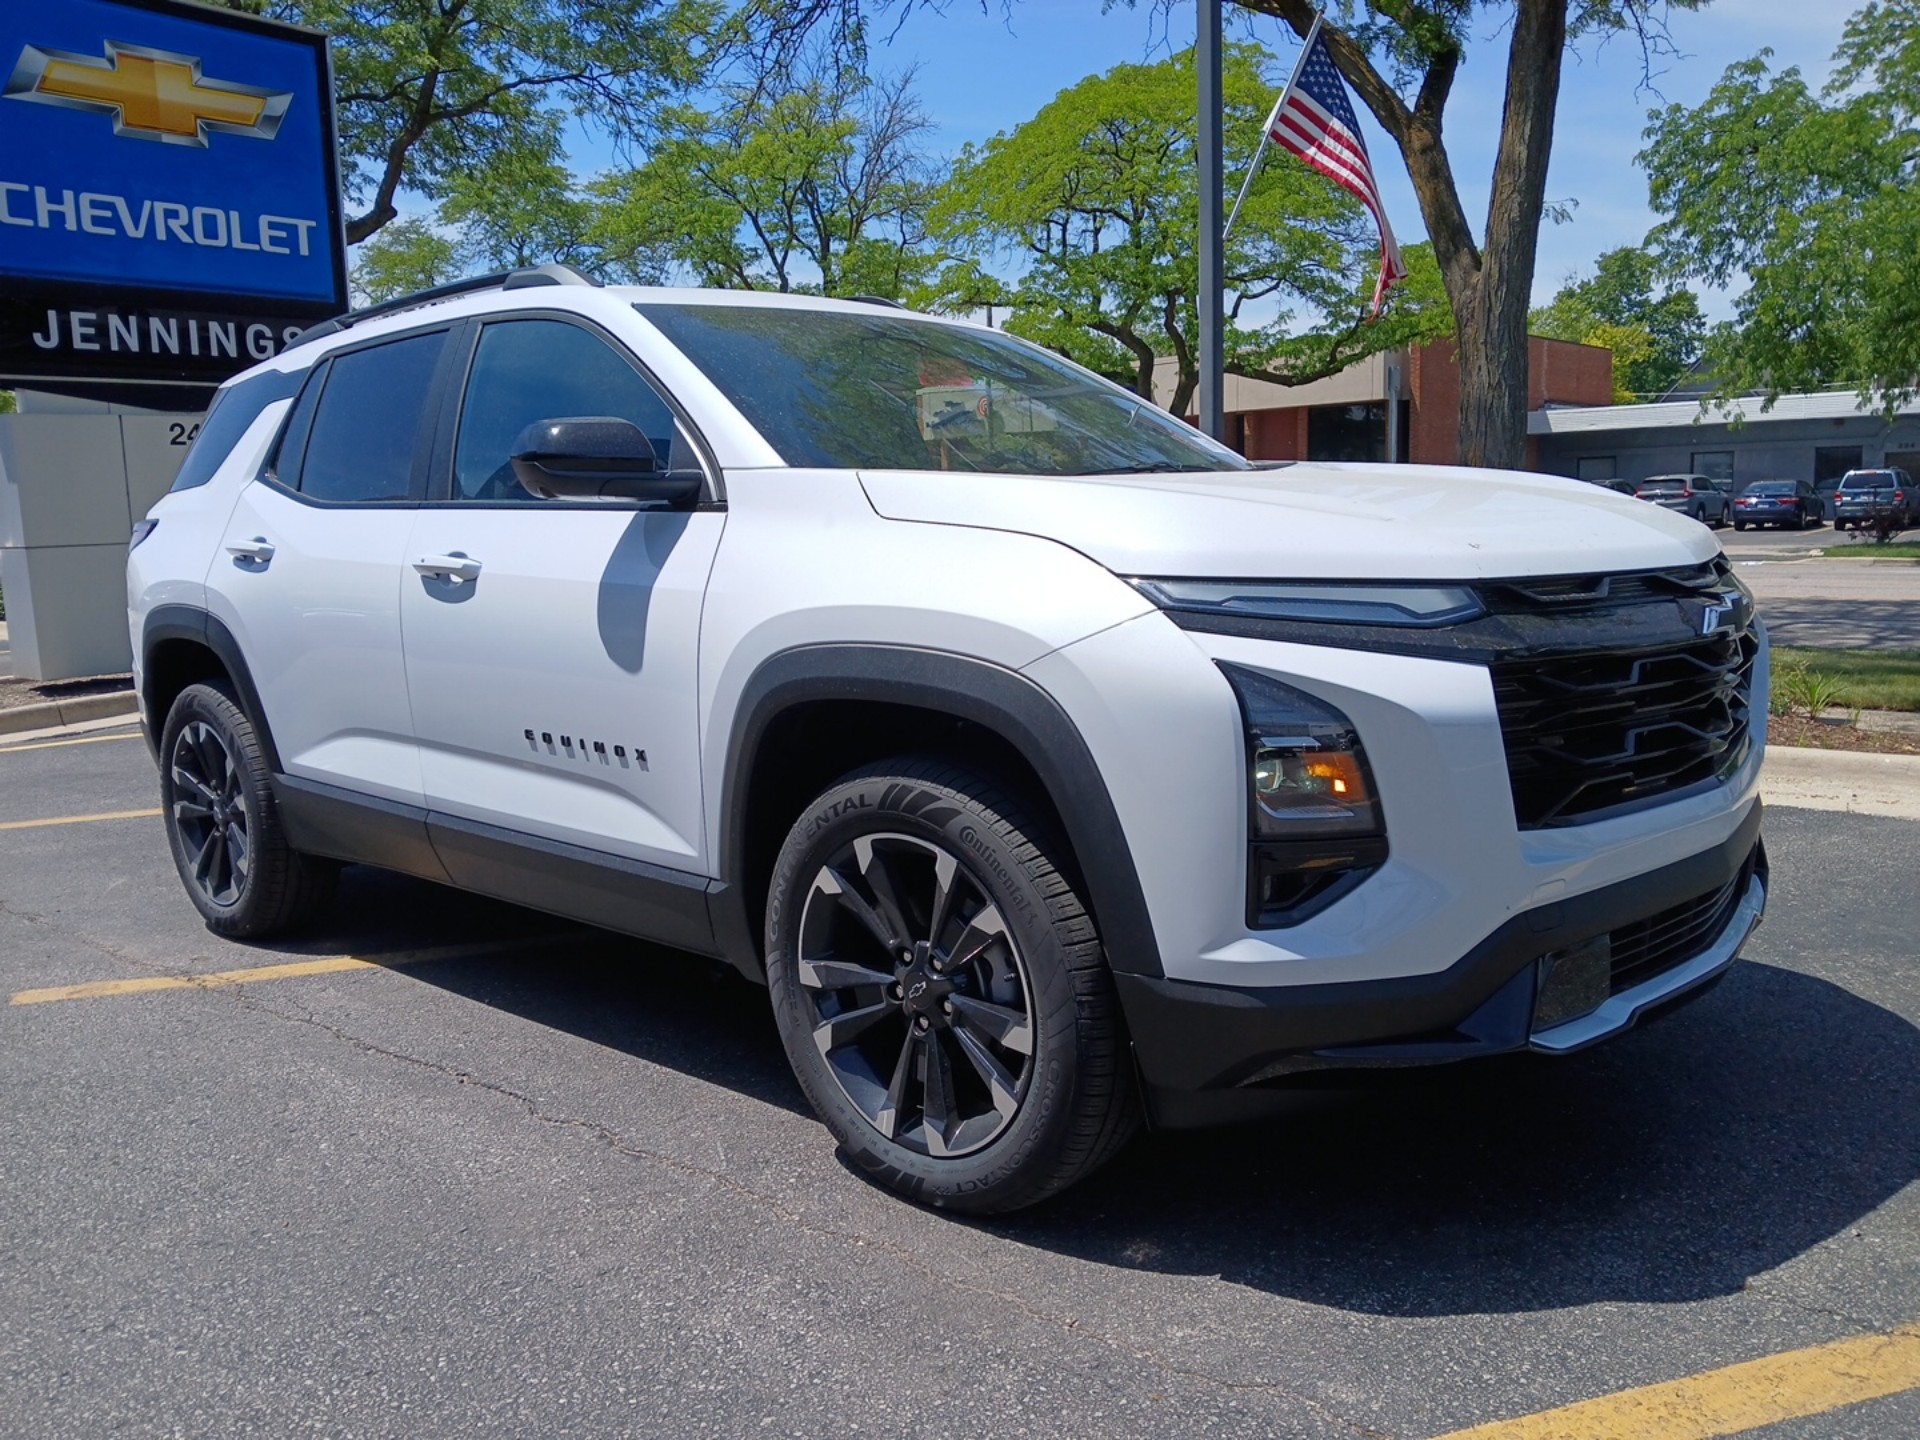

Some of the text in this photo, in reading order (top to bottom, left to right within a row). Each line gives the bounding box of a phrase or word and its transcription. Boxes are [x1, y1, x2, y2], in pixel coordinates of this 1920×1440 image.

[0, 181, 317, 256] CHEVROLET
[524, 728, 647, 762] EQUINOX
[959, 825, 1031, 912] Continental
